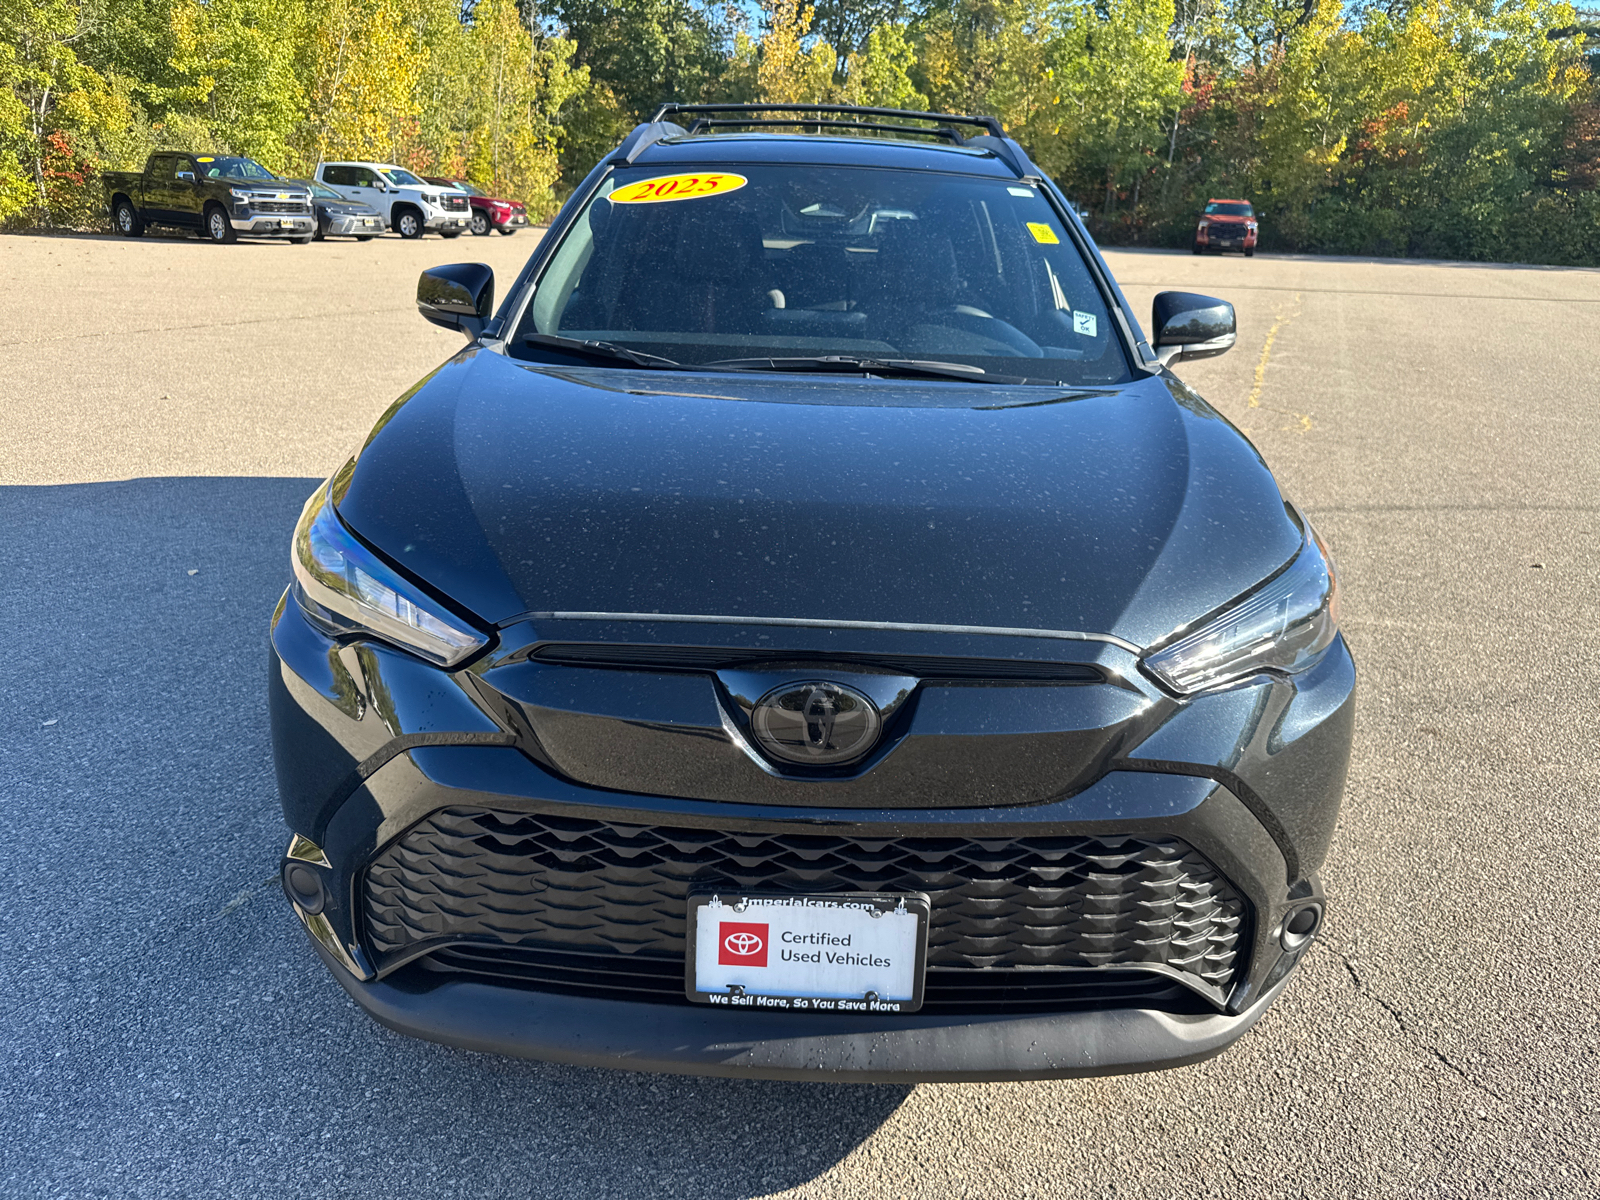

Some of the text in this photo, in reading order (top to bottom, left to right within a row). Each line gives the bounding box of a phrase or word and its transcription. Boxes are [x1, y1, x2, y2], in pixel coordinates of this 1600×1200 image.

[630, 176, 724, 200] 2025
[1075, 313, 1095, 321] SAFETY
[781, 931, 852, 947] Certified
[781, 949, 891, 968] Used Vehicles
[709, 994, 901, 1011] We Sell More, So You Save More
